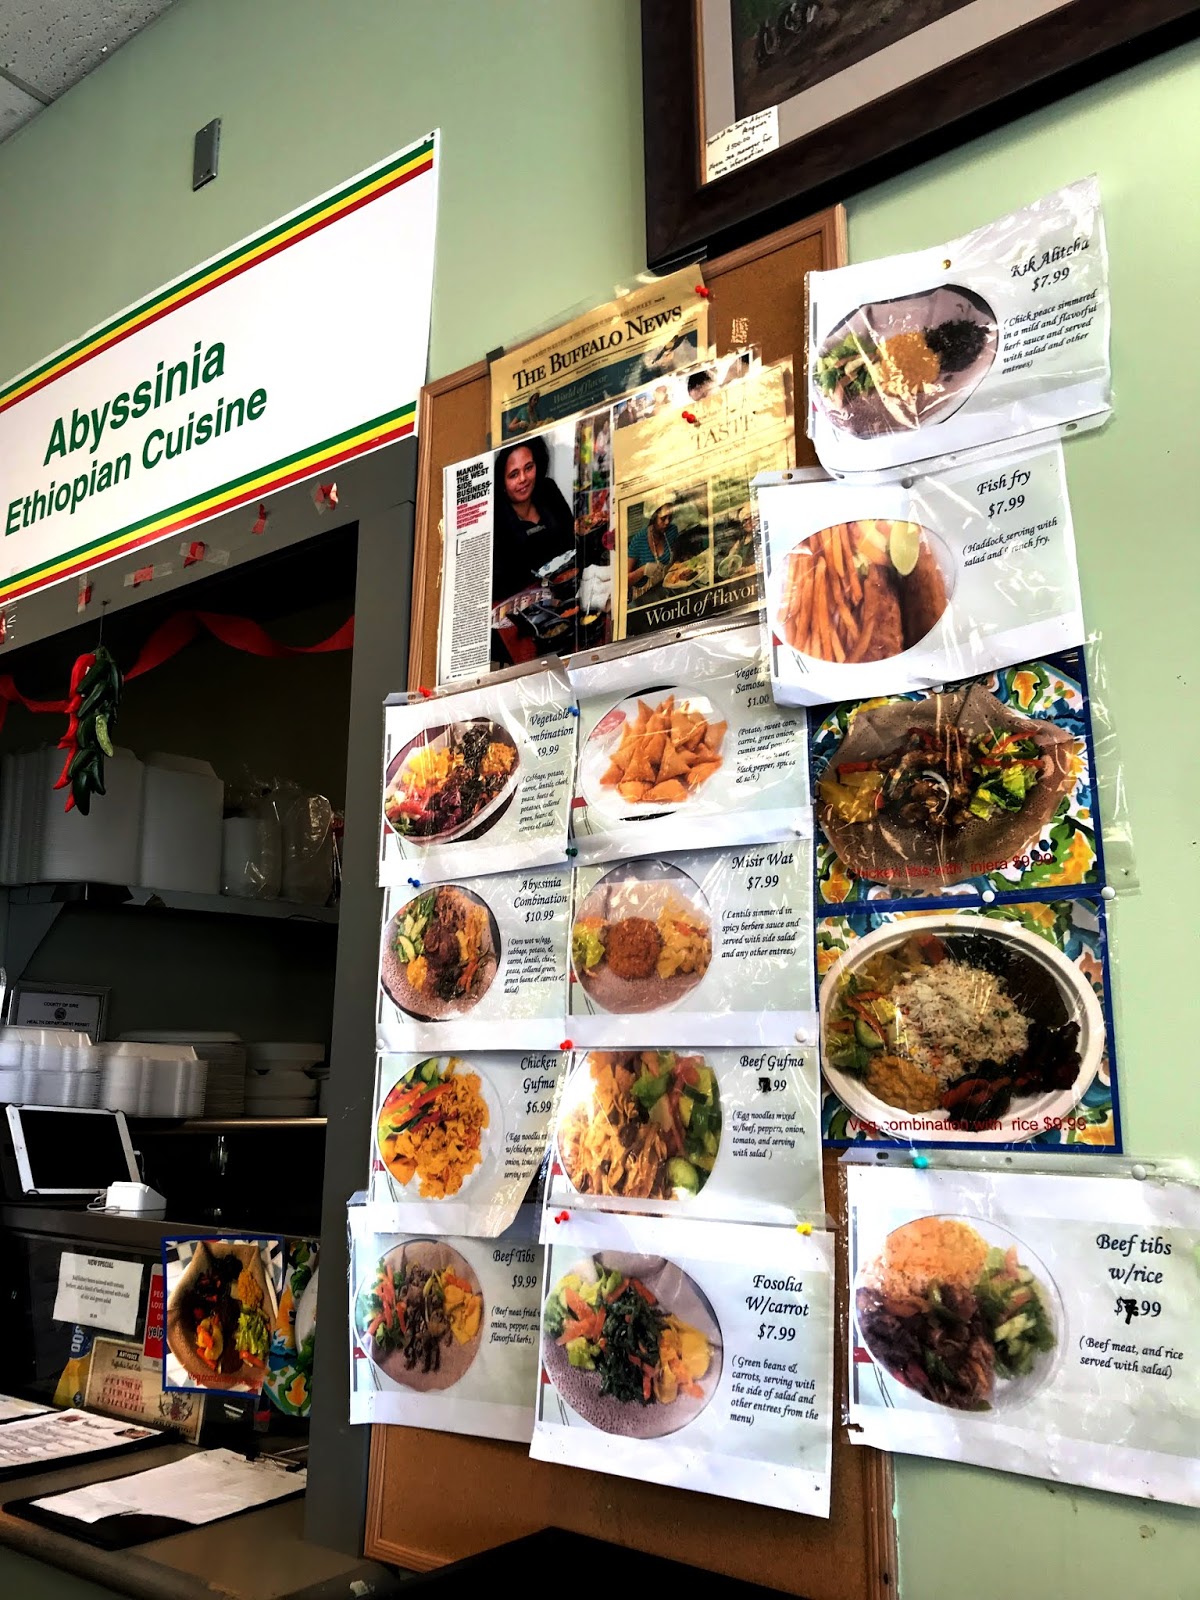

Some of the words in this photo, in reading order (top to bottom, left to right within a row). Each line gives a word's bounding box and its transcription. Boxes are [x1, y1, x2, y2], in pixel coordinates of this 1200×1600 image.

[1036, 237, 1090, 271] Alitcha
[1032, 267, 1070, 292] $7.99
[1033, 306, 1056, 320] peace
[1058, 288, 1098, 310] simmered
[1004, 332, 1012, 340] in
[1021, 323, 1039, 334] mild
[1041, 318, 1056, 328] and
[1057, 304, 1097, 326] flavorful
[1023, 335, 1045, 346] sauce
[1046, 327, 1062, 339] and
[1064, 318, 1091, 333] served
[513, 363, 547, 391] THE
[549, 331, 622, 375] BUFFALO
[625, 305, 682, 341] NEWS
[1003, 353, 1023, 363] with
[1024, 345, 1046, 357] salad
[1048, 338, 1064, 349] and
[1066, 333, 1089, 343] other
[1002, 360, 1033, 374] entrees)
[43, 339, 226, 466] Abyssinia
[4, 450, 132, 537] Ethiopian
[141, 387, 268, 469] Cuisine
[457, 462, 483, 477] MAKING
[457, 475, 469, 484] THE
[471, 467, 489, 479] WEST
[977, 474, 1007, 495] Fish
[1007, 470, 1031, 490] fry
[457, 480, 472, 491] SIDE
[457, 480, 492, 498] BUSINESS-
[457, 489, 490, 505] FRIENDLY:
[988, 494, 1025, 519] $7.99
[1006, 527, 1035, 540] serving
[1037, 517, 1058, 530] with
[964, 553, 985, 567] salad
[987, 548, 1002, 560] and
[1034, 535, 1050, 548] fry.
[645, 599, 690, 626] World
[694, 592, 712, 616] of
[713, 584, 759, 607] flavor
[736, 681, 765, 694] Samosa
[747, 694, 769, 708] $1.00
[530, 708, 570, 727] Vegetable
[738, 727, 762, 737] (Potato,
[764, 722, 780, 730] sweet
[738, 737, 756, 745] carrot,
[758, 734, 774, 743] green
[776, 730, 794, 738] onion,
[738, 746, 755, 754] cumin
[757, 742, 771, 751] seed
[754, 763, 774, 772] pepper,
[732, 854, 764, 869] Misir
[766, 851, 794, 865] Wat
[970, 860, 1008, 874] injera
[747, 875, 779, 891] $7.99
[514, 894, 567, 908] Combination
[525, 910, 554, 923] $10.99
[722, 924, 739, 934] spicy
[741, 921, 764, 931] berbere
[765, 921, 783, 929] sauce
[786, 918, 801, 927] and
[722, 935, 746, 945] served
[745, 934, 761, 944] with
[762, 933, 775, 942] side
[777, 932, 797, 941] salad
[722, 949, 736, 958] and
[736, 950, 748, 959] any
[750, 947, 768, 956] other
[769, 948, 796, 956] entrees)
[520, 1055, 557, 1070] Chicken
[740, 1054, 766, 1071] Beef
[768, 1054, 804, 1071] Gufma
[523, 1076, 555, 1093] Gufma
[526, 1101, 551, 1115] $6.99
[751, 1111, 774, 1119] noodles
[776, 1112, 796, 1120] mixed
[733, 1123, 756, 1133] w/beef,
[785, 1126, 805, 1134] onion,
[883, 1117, 968, 1131] combination
[972, 1118, 1002, 1131] with
[1012, 1117, 1038, 1130] rice
[1043, 1116, 1086, 1132] $9.99
[733, 1137, 756, 1145] tomato,
[758, 1137, 771, 1145] and
[772, 1137, 795, 1148] serving
[733, 1149, 747, 1157] with
[1096, 1234, 1138, 1257] Beef
[1140, 1237, 1172, 1255] tibs
[493, 1249, 515, 1266] Beef
[516, 1249, 535, 1262] Tibs
[512, 1274, 537, 1289] $9.99
[1109, 1264, 1163, 1284] w/rice
[753, 1274, 802, 1292] Fosolia
[522, 1307, 537, 1318] fried
[745, 1295, 809, 1316] W/carrot
[148, 1325, 163, 1341] yelp
[490, 1321, 507, 1330] onion,
[509, 1323, 529, 1331] pepper,
[757, 1323, 796, 1341] $7.99
[490, 1332, 516, 1344] flavorful
[1112, 1341, 1138, 1355] meat,
[1142, 1346, 1163, 1357] and
[1165, 1348, 1184, 1360] rice
[763, 1359, 786, 1371] beans
[788, 1363, 798, 1374] &
[1080, 1356, 1113, 1368] served
[1114, 1359, 1138, 1372] with
[1141, 1363, 1172, 1379] salad)
[732, 1371, 761, 1383] carrots,
[764, 1376, 793, 1389] serving
[795, 1380, 815, 1390] with
[732, 1383, 744, 1393] the
[746, 1384, 762, 1396] side
[764, 1388, 773, 1400] of
[774, 1391, 798, 1402] salad
[798, 1394, 816, 1405] and
[730, 1399, 752, 1409] other
[753, 1403, 781, 1414] entrees
[781, 1405, 803, 1418] from
[805, 1409, 819, 1420] the
[730, 1413, 754, 1426] menu)
